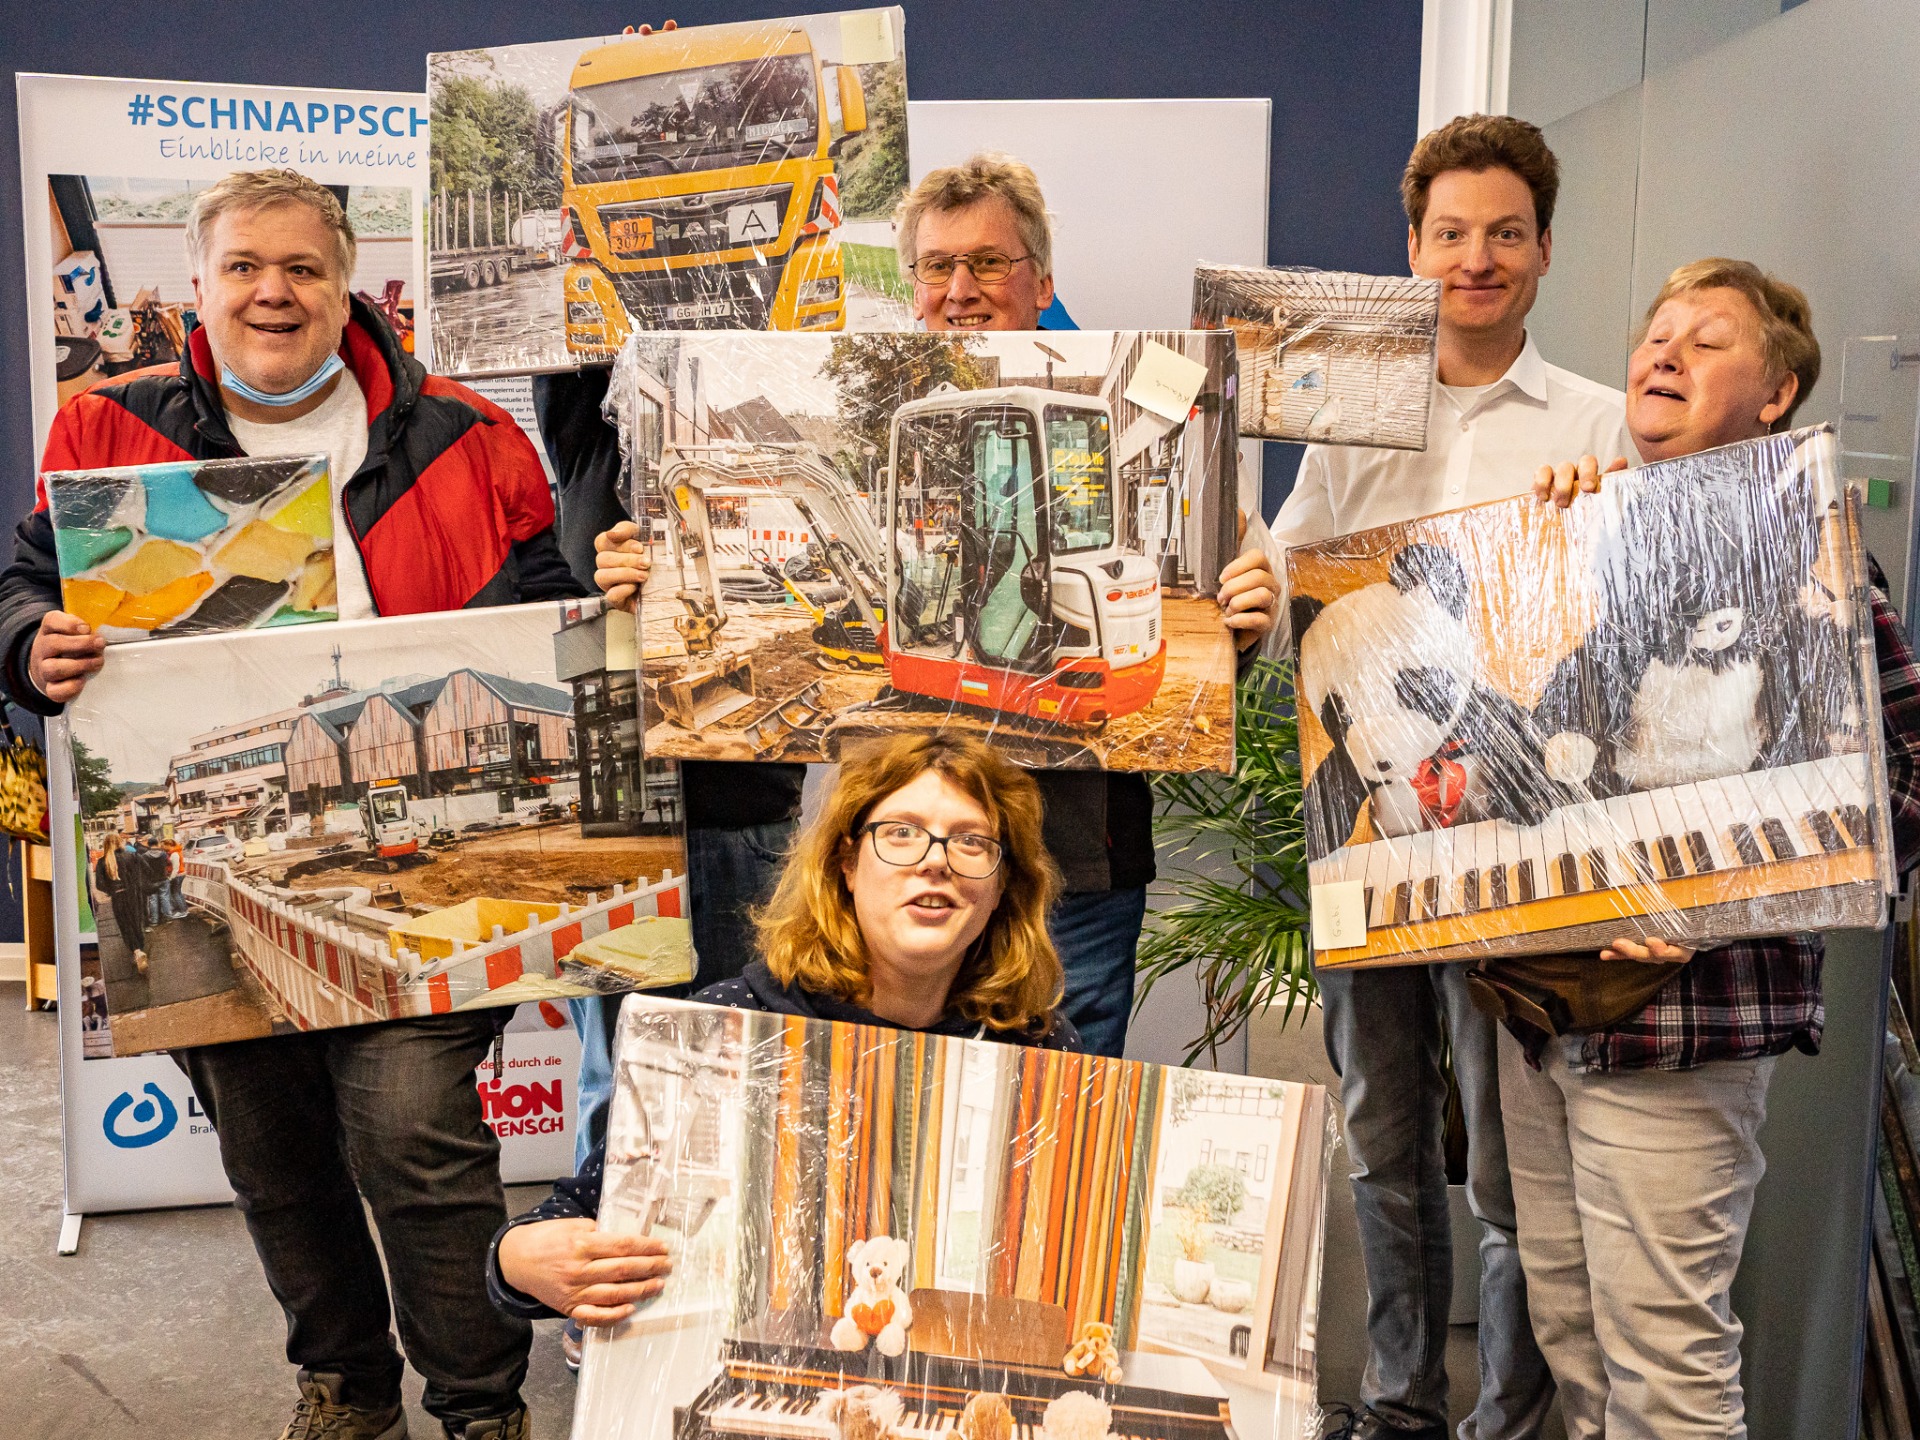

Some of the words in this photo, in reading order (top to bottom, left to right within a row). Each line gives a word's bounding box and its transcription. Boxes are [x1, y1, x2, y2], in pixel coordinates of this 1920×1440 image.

[128, 94, 428, 138] #SCHNAPPSCH
[160, 136, 290, 164] Einblicke
[299, 140, 329, 163] in
[338, 144, 417, 168] meine
[623, 221, 639, 234] 90
[741, 209, 767, 236] A
[616, 234, 648, 250] 3077
[508, 1056, 541, 1069] durch
[544, 1055, 562, 1067] die
